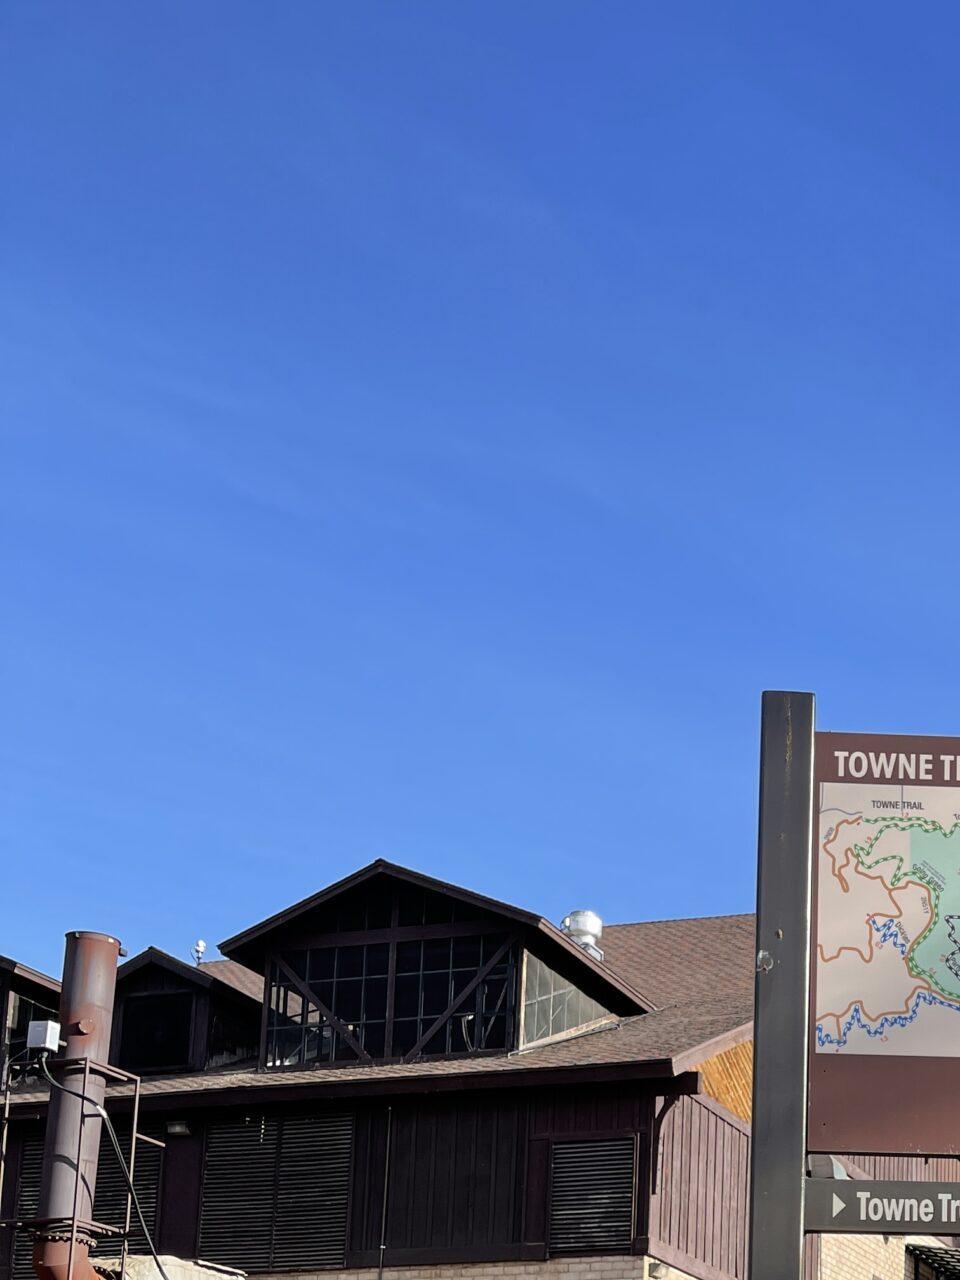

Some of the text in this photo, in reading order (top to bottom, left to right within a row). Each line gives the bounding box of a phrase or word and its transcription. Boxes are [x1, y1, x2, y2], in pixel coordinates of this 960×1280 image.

[834, 751, 933, 780] TOWNE
[872, 800, 924, 810] TOWNE TRAIL
[912, 863, 928, 879] Going
[929, 877, 944, 893] Green
[856, 1191, 934, 1222] Towne
